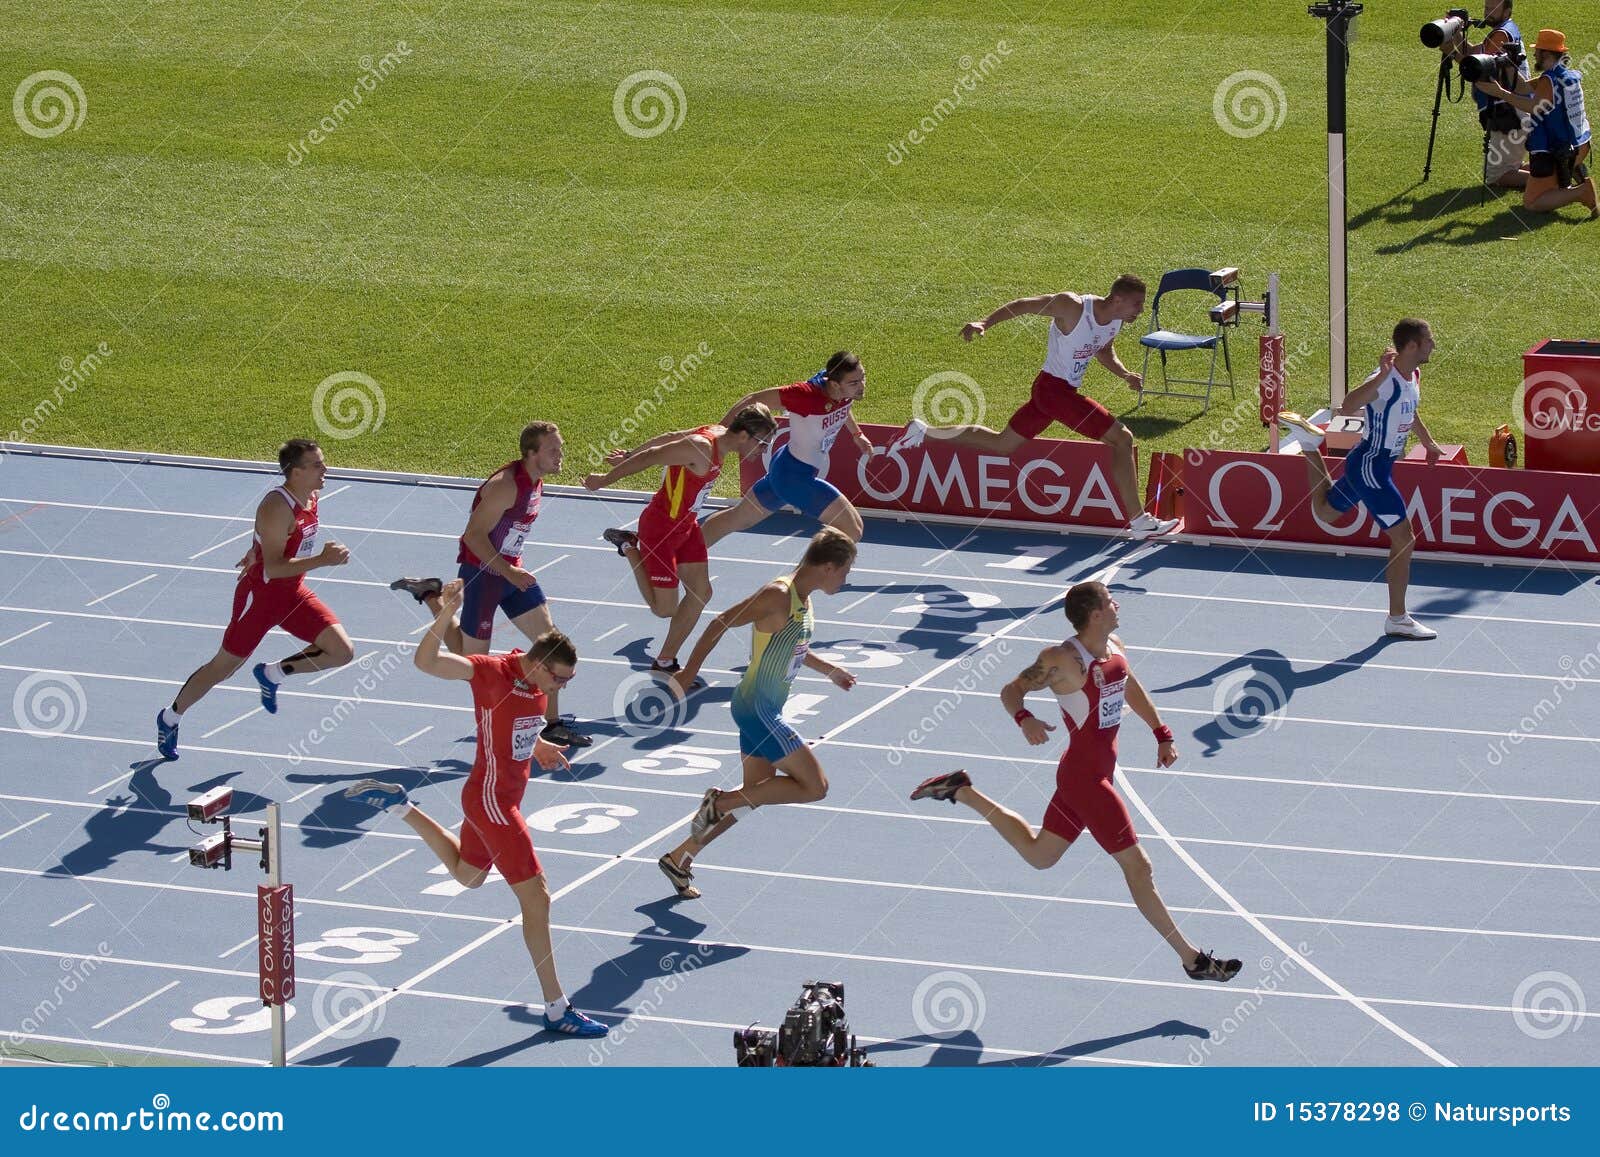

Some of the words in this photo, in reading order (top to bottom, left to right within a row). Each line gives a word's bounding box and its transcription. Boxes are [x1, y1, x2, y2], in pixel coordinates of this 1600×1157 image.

[857, 446, 1125, 521] OMEGA
[525, 802, 641, 835] 6
[262, 892, 275, 972] OMEGA
[281, 888, 292, 970] OMEGA
[293, 926, 421, 964] 8
